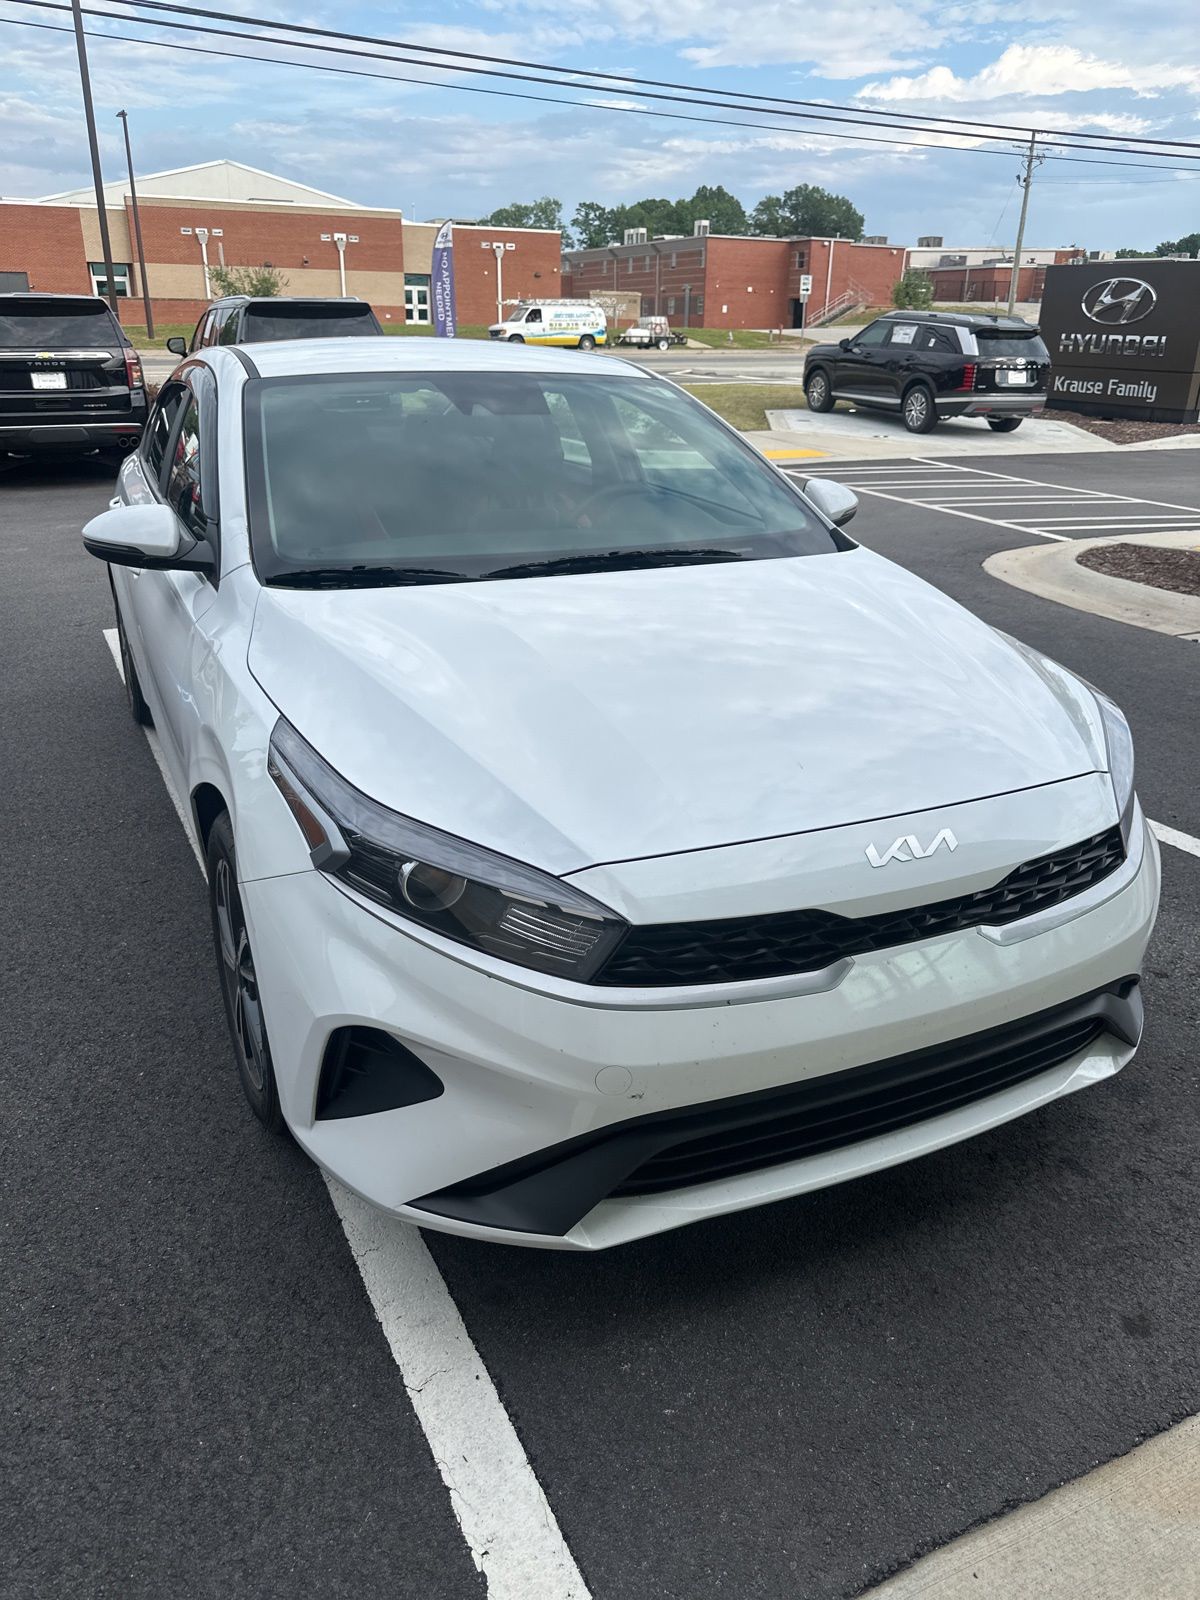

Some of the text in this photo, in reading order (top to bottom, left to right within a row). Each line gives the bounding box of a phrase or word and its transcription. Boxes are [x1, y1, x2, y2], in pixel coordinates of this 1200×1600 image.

[441, 252, 449, 269] NO
[436, 281, 446, 321] NEEDED
[442, 270, 455, 339] APPOINTMEN
[1059, 333, 1167, 357] HYUNDAI
[1053, 375, 1157, 402] Krause Family
[864, 828, 959, 868] KIA
